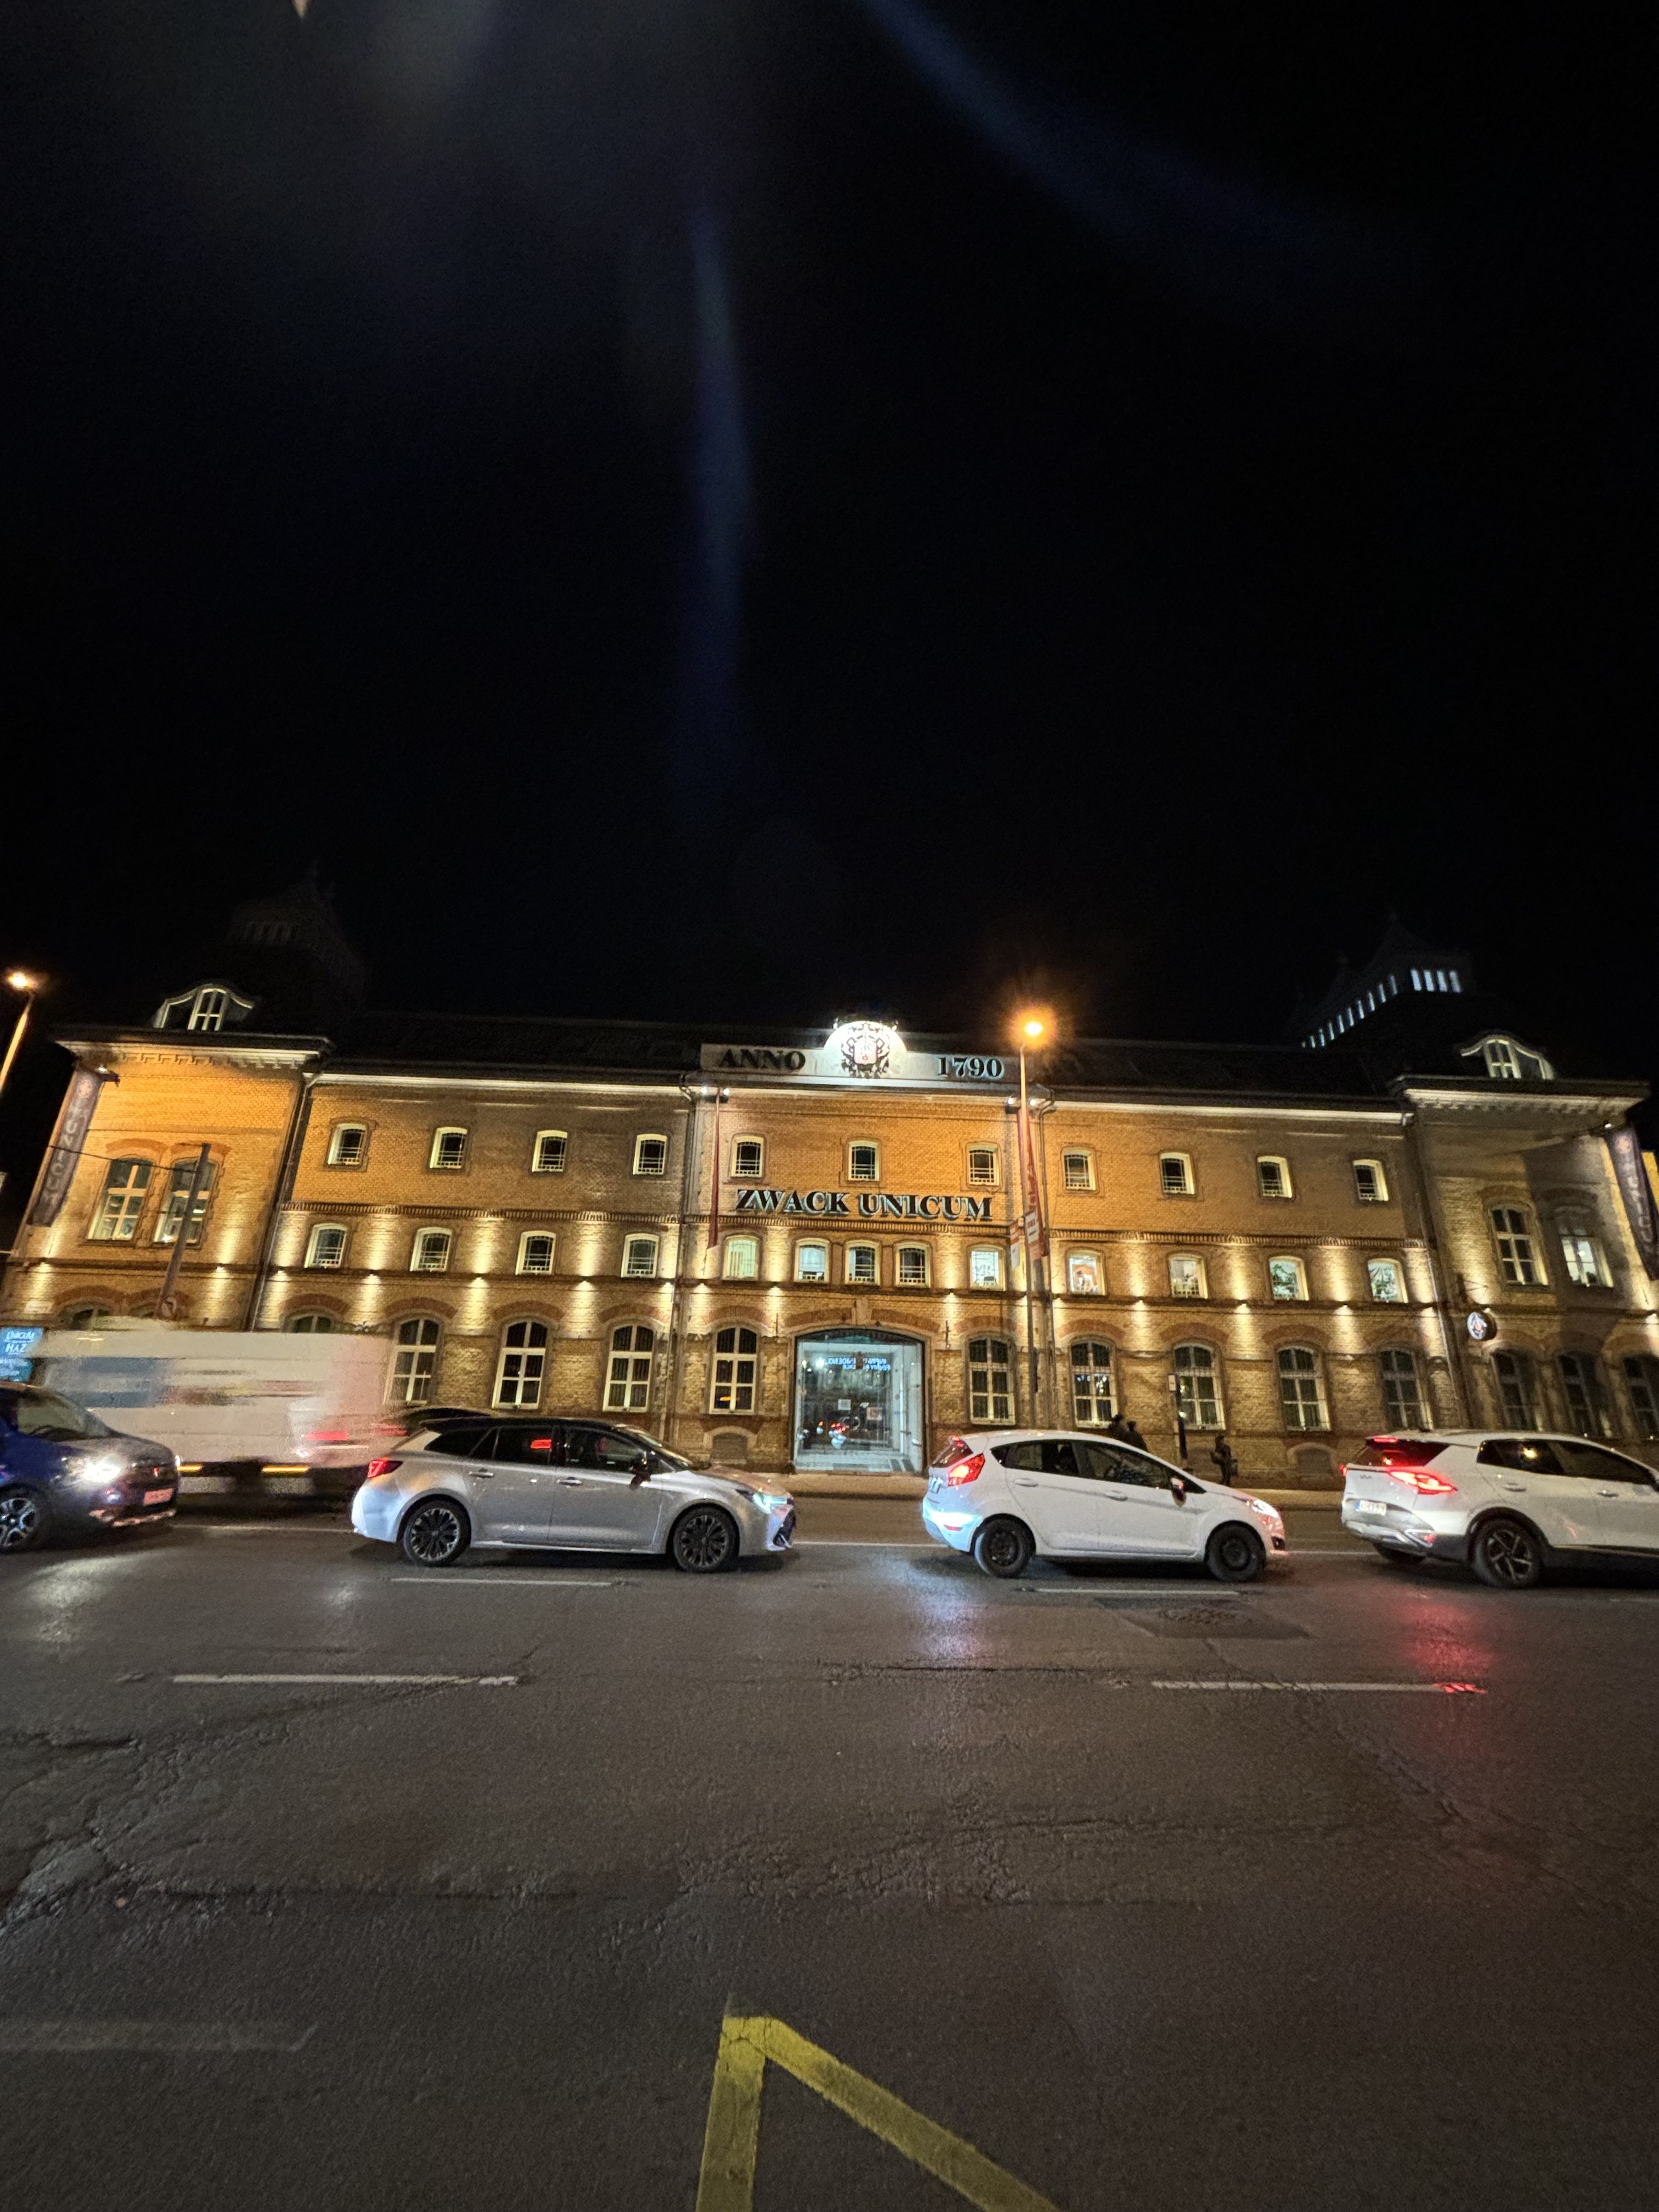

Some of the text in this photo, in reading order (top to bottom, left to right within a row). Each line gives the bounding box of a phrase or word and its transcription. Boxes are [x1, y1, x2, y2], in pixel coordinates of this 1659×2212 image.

[718, 1049, 1004, 1078] ANNO 1790
[735, 1189, 993, 1222] ZWACK UNICUM
